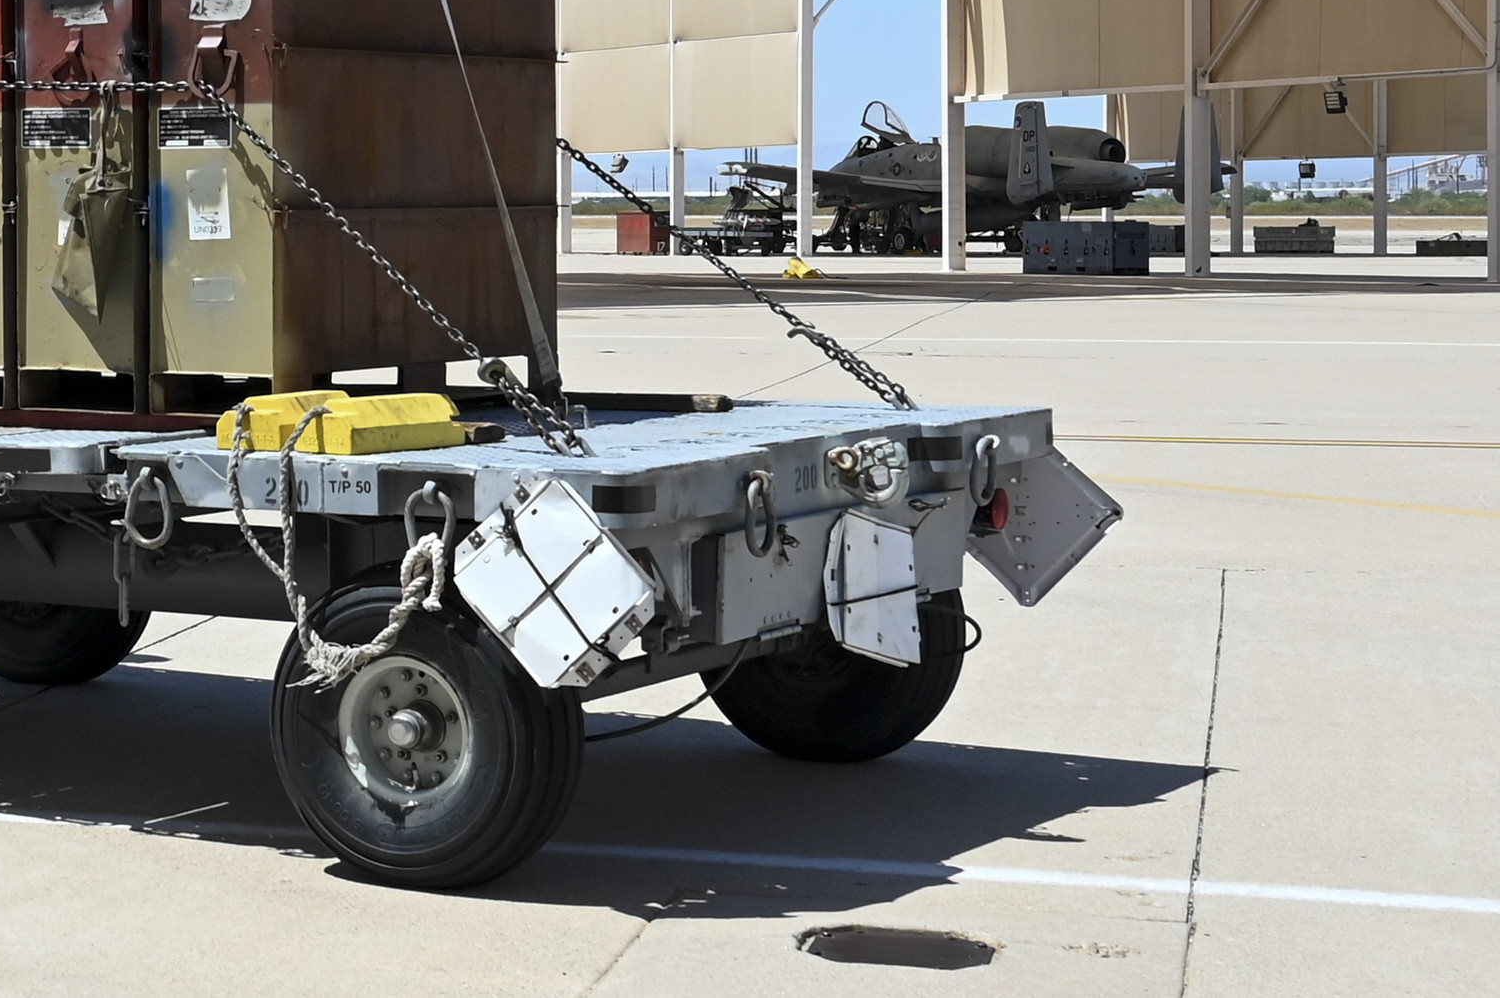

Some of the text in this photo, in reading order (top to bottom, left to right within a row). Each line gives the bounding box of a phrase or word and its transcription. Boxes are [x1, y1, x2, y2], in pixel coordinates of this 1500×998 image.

[1023, 130, 1035, 142] DP
[329, 480, 371, 494] T/P 50
[795, 464, 818, 492] 200
[265, 477, 309, 506] 20
